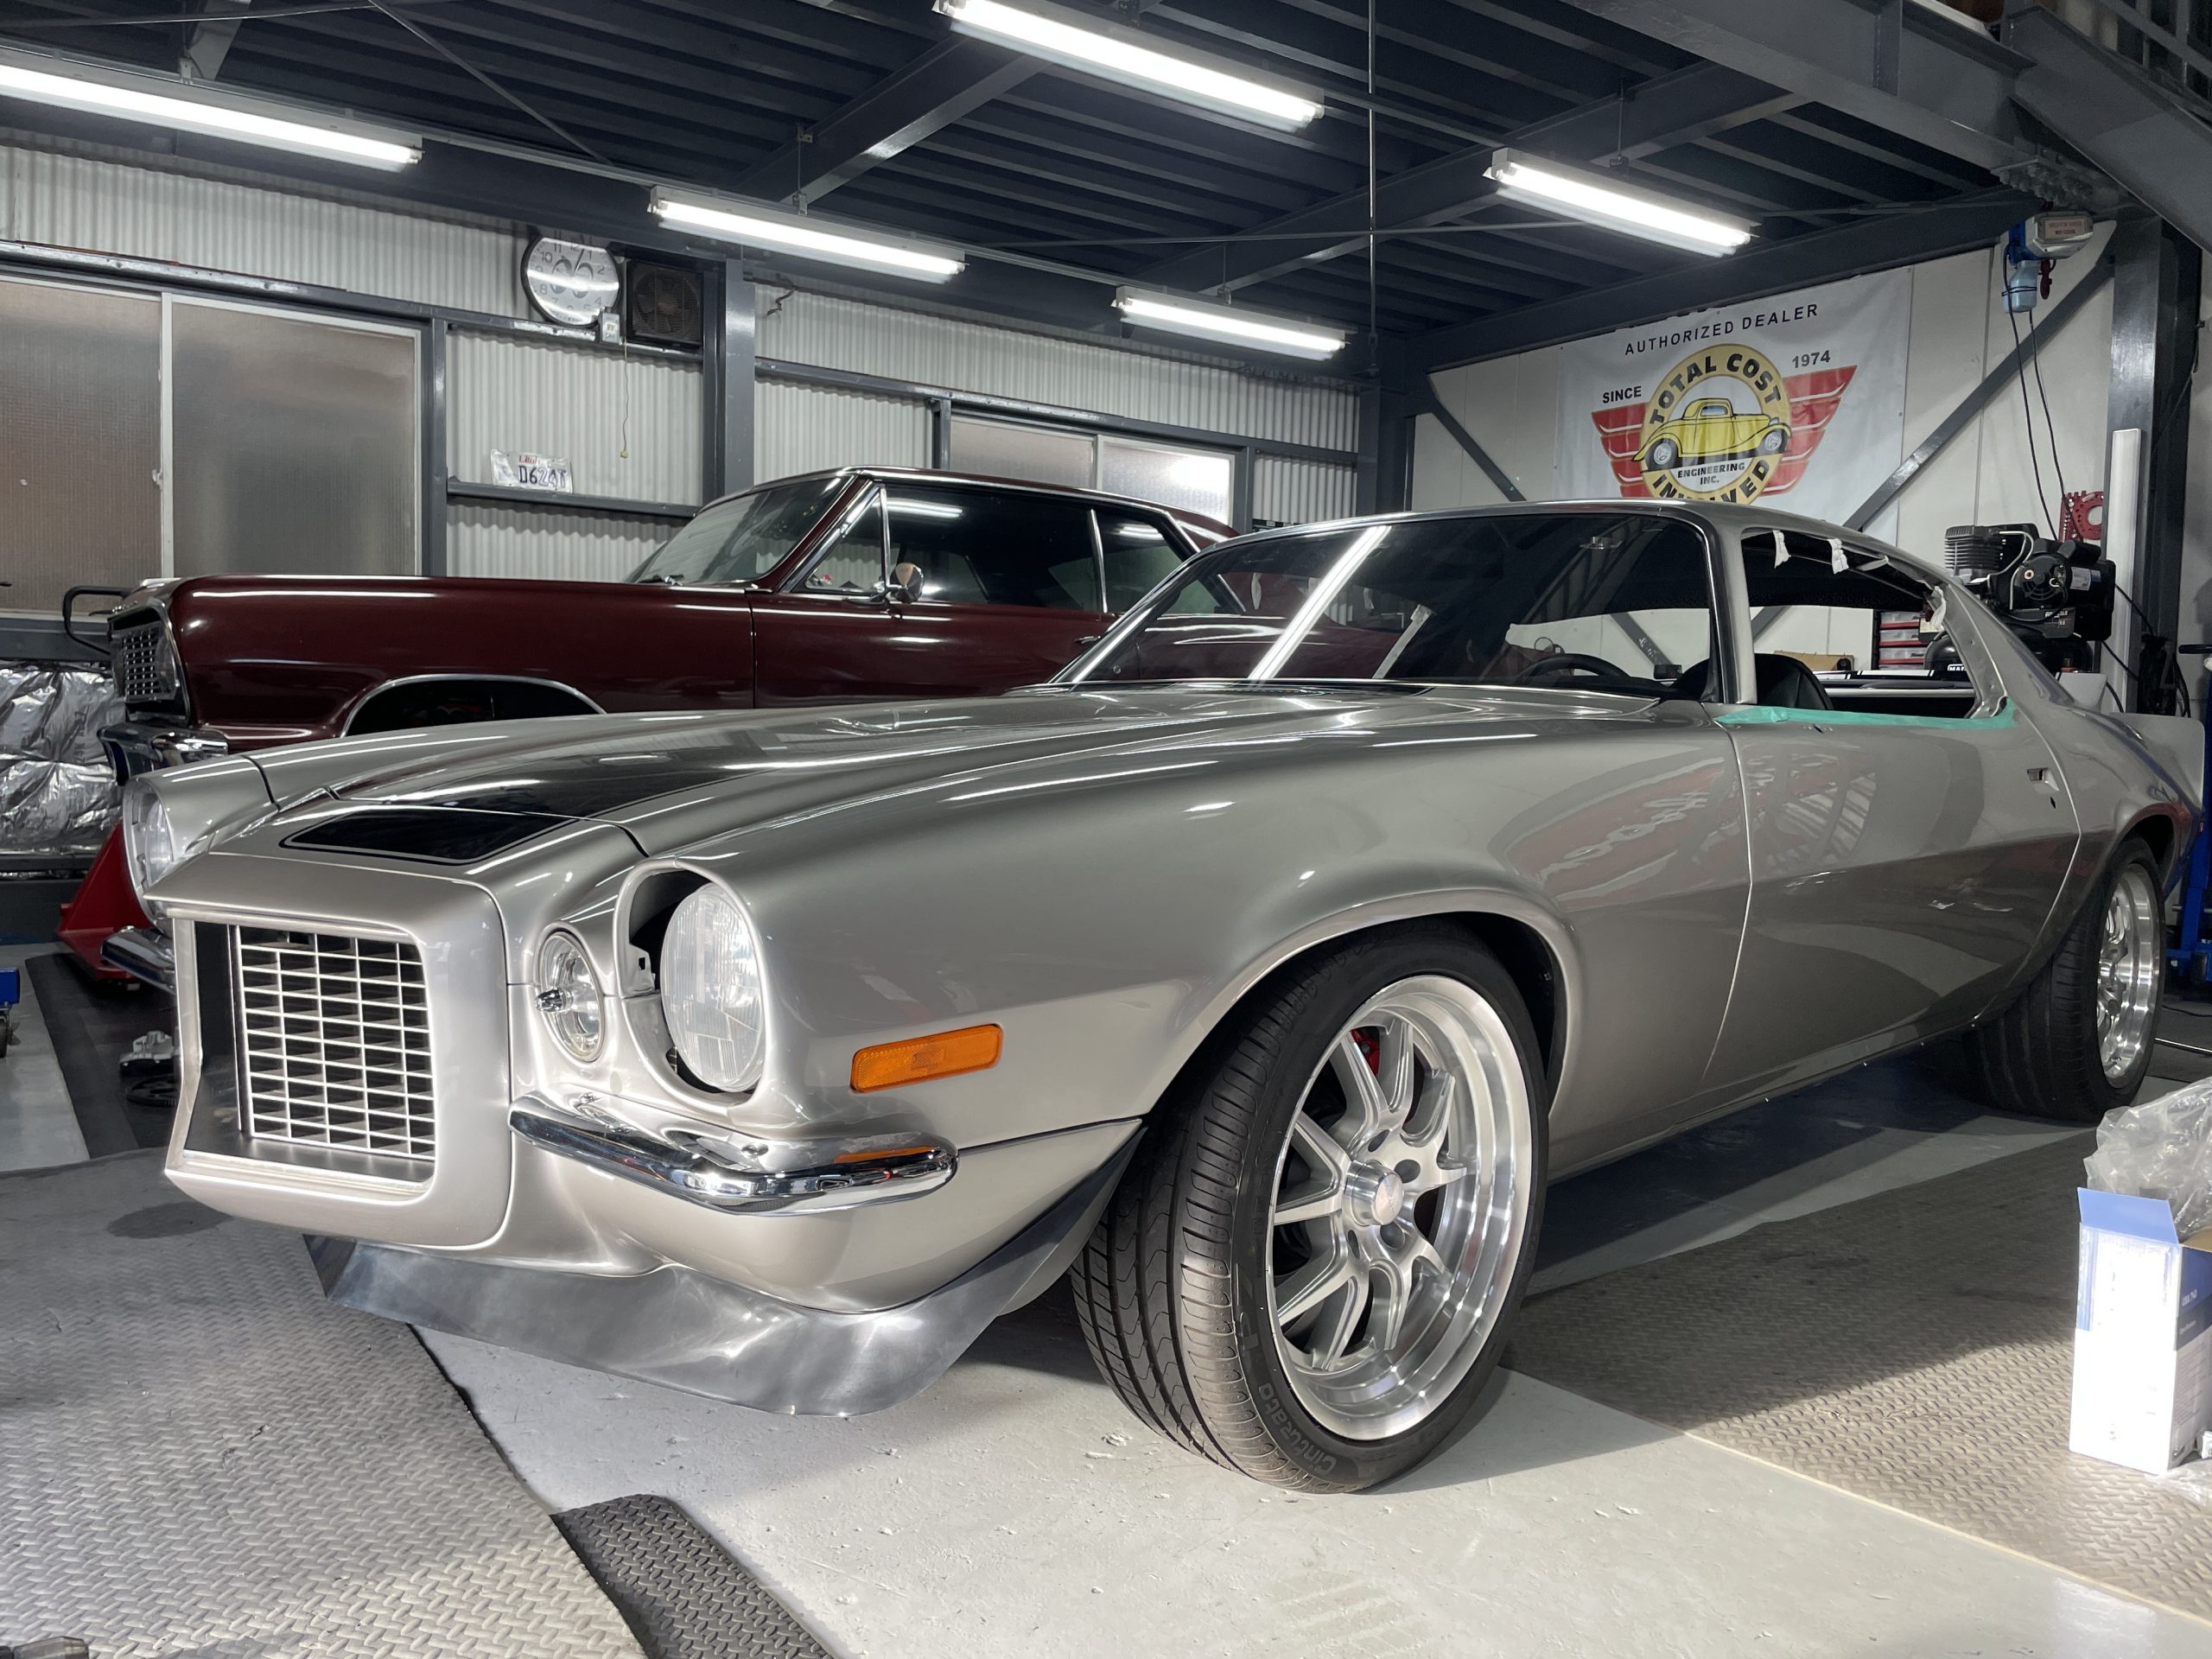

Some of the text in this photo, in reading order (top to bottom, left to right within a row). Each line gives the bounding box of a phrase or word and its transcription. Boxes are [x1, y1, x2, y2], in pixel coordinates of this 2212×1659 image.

[1624, 303, 1818, 356] AUTHORIZED DEALER
[1792, 350, 1831, 369] 1974
[1602, 385, 1642, 404] SINCE
[1649, 353, 1782, 425] TOTAL COST
[1652, 459, 1770, 504] INVED
[1677, 462, 1745, 479] ENGINEERING
[1700, 475, 1719, 486] INC.
[1258, 1382, 1338, 1475] Cinturato
